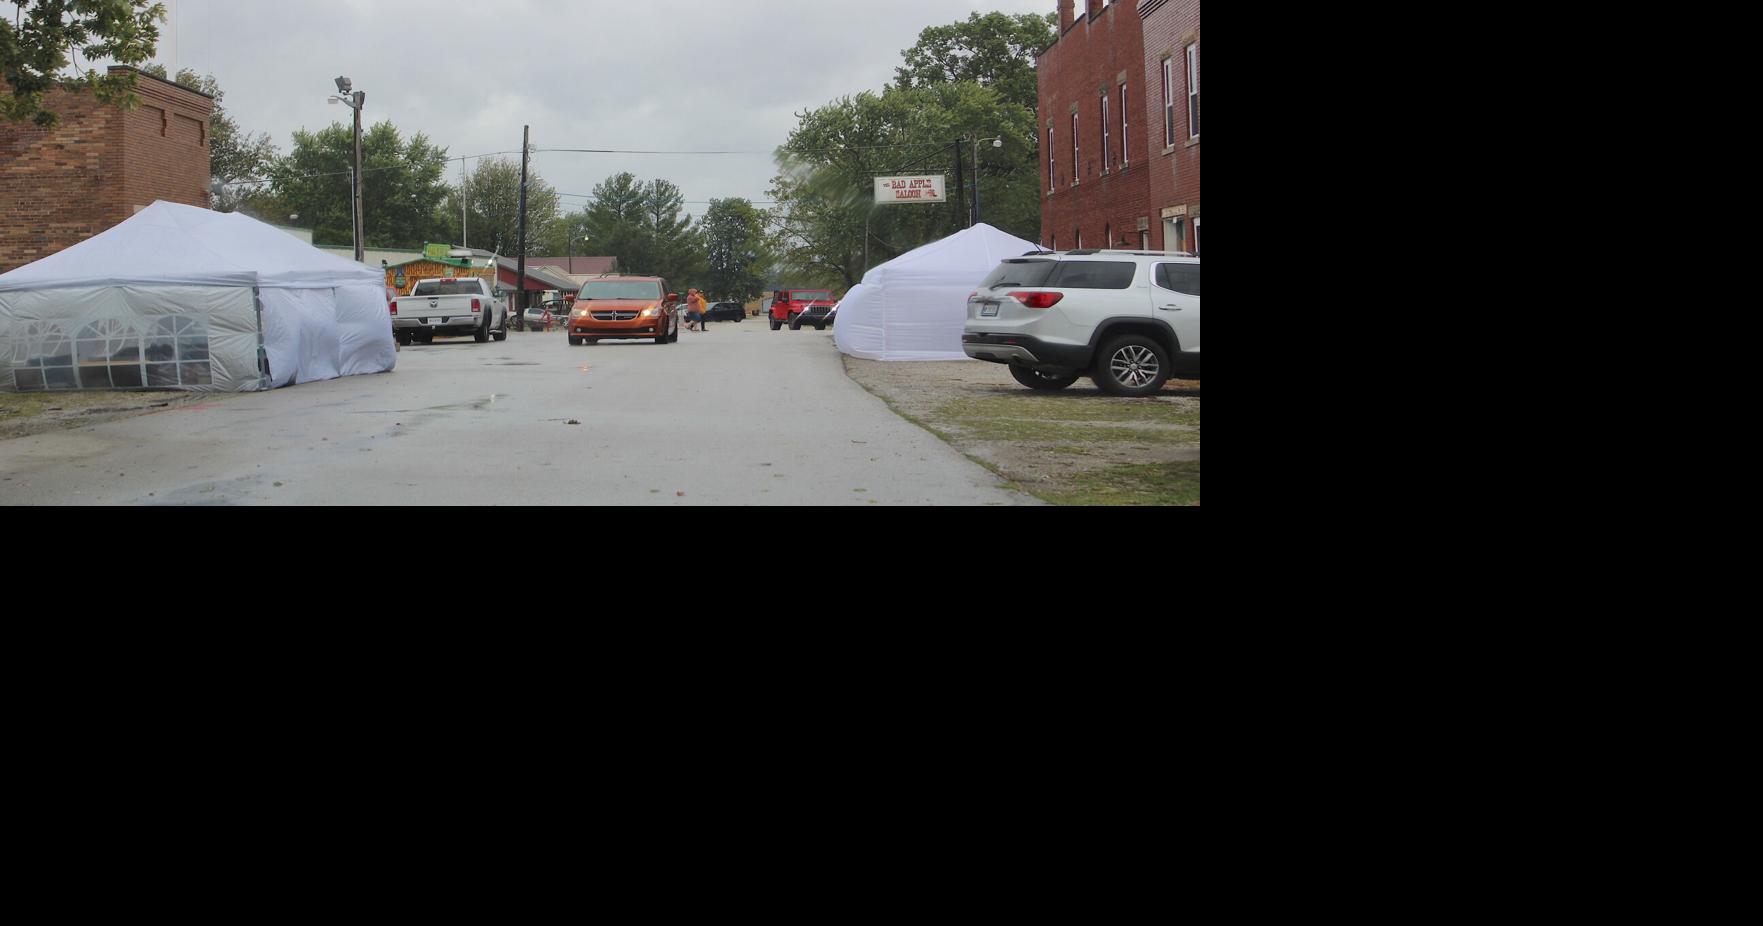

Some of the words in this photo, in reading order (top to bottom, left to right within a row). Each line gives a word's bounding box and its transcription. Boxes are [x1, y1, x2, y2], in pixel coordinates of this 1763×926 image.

[892, 180, 906, 189] BAD
[909, 180, 932, 188] APPLE
[896, 190, 922, 198] SALOON
